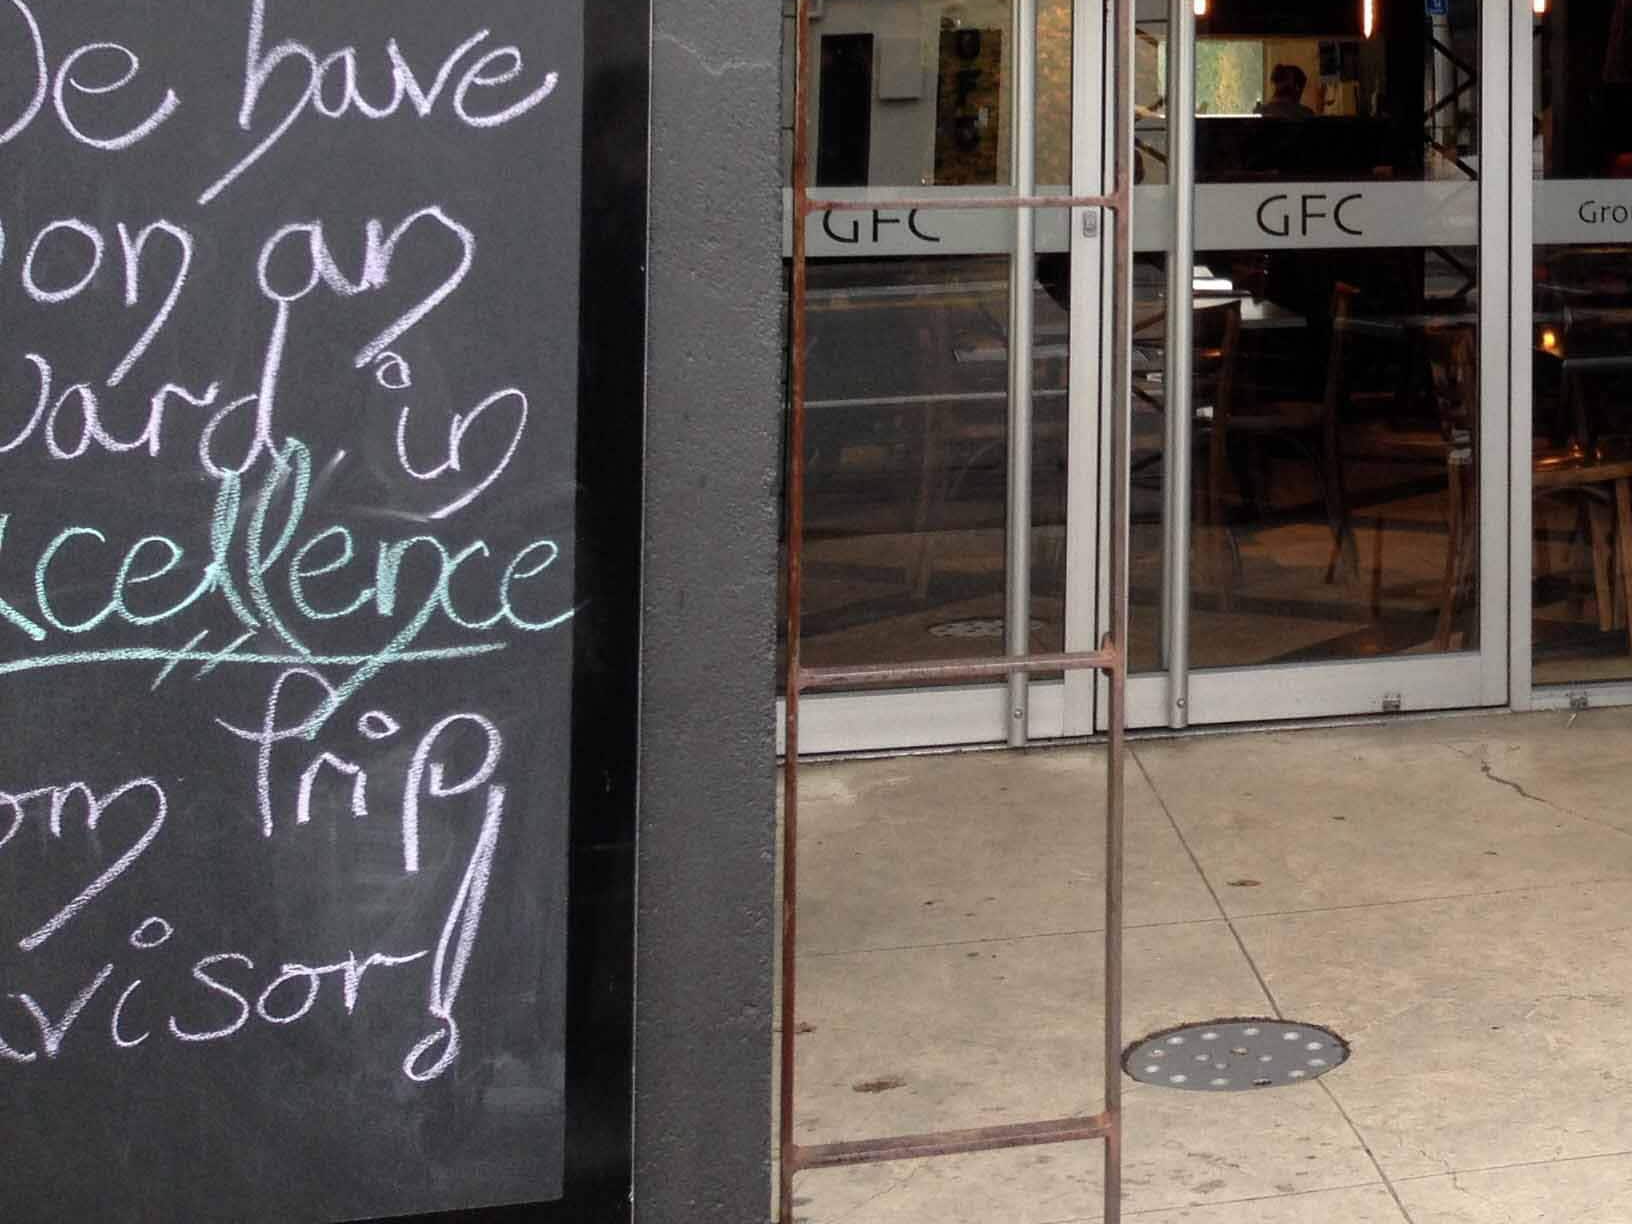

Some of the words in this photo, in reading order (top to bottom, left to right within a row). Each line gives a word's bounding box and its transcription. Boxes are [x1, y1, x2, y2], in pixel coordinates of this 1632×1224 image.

[0, 216, 194, 388] on
[257, 204, 476, 369] an
[1256, 193, 1363, 237] GFC
[375, 350, 528, 522] in
